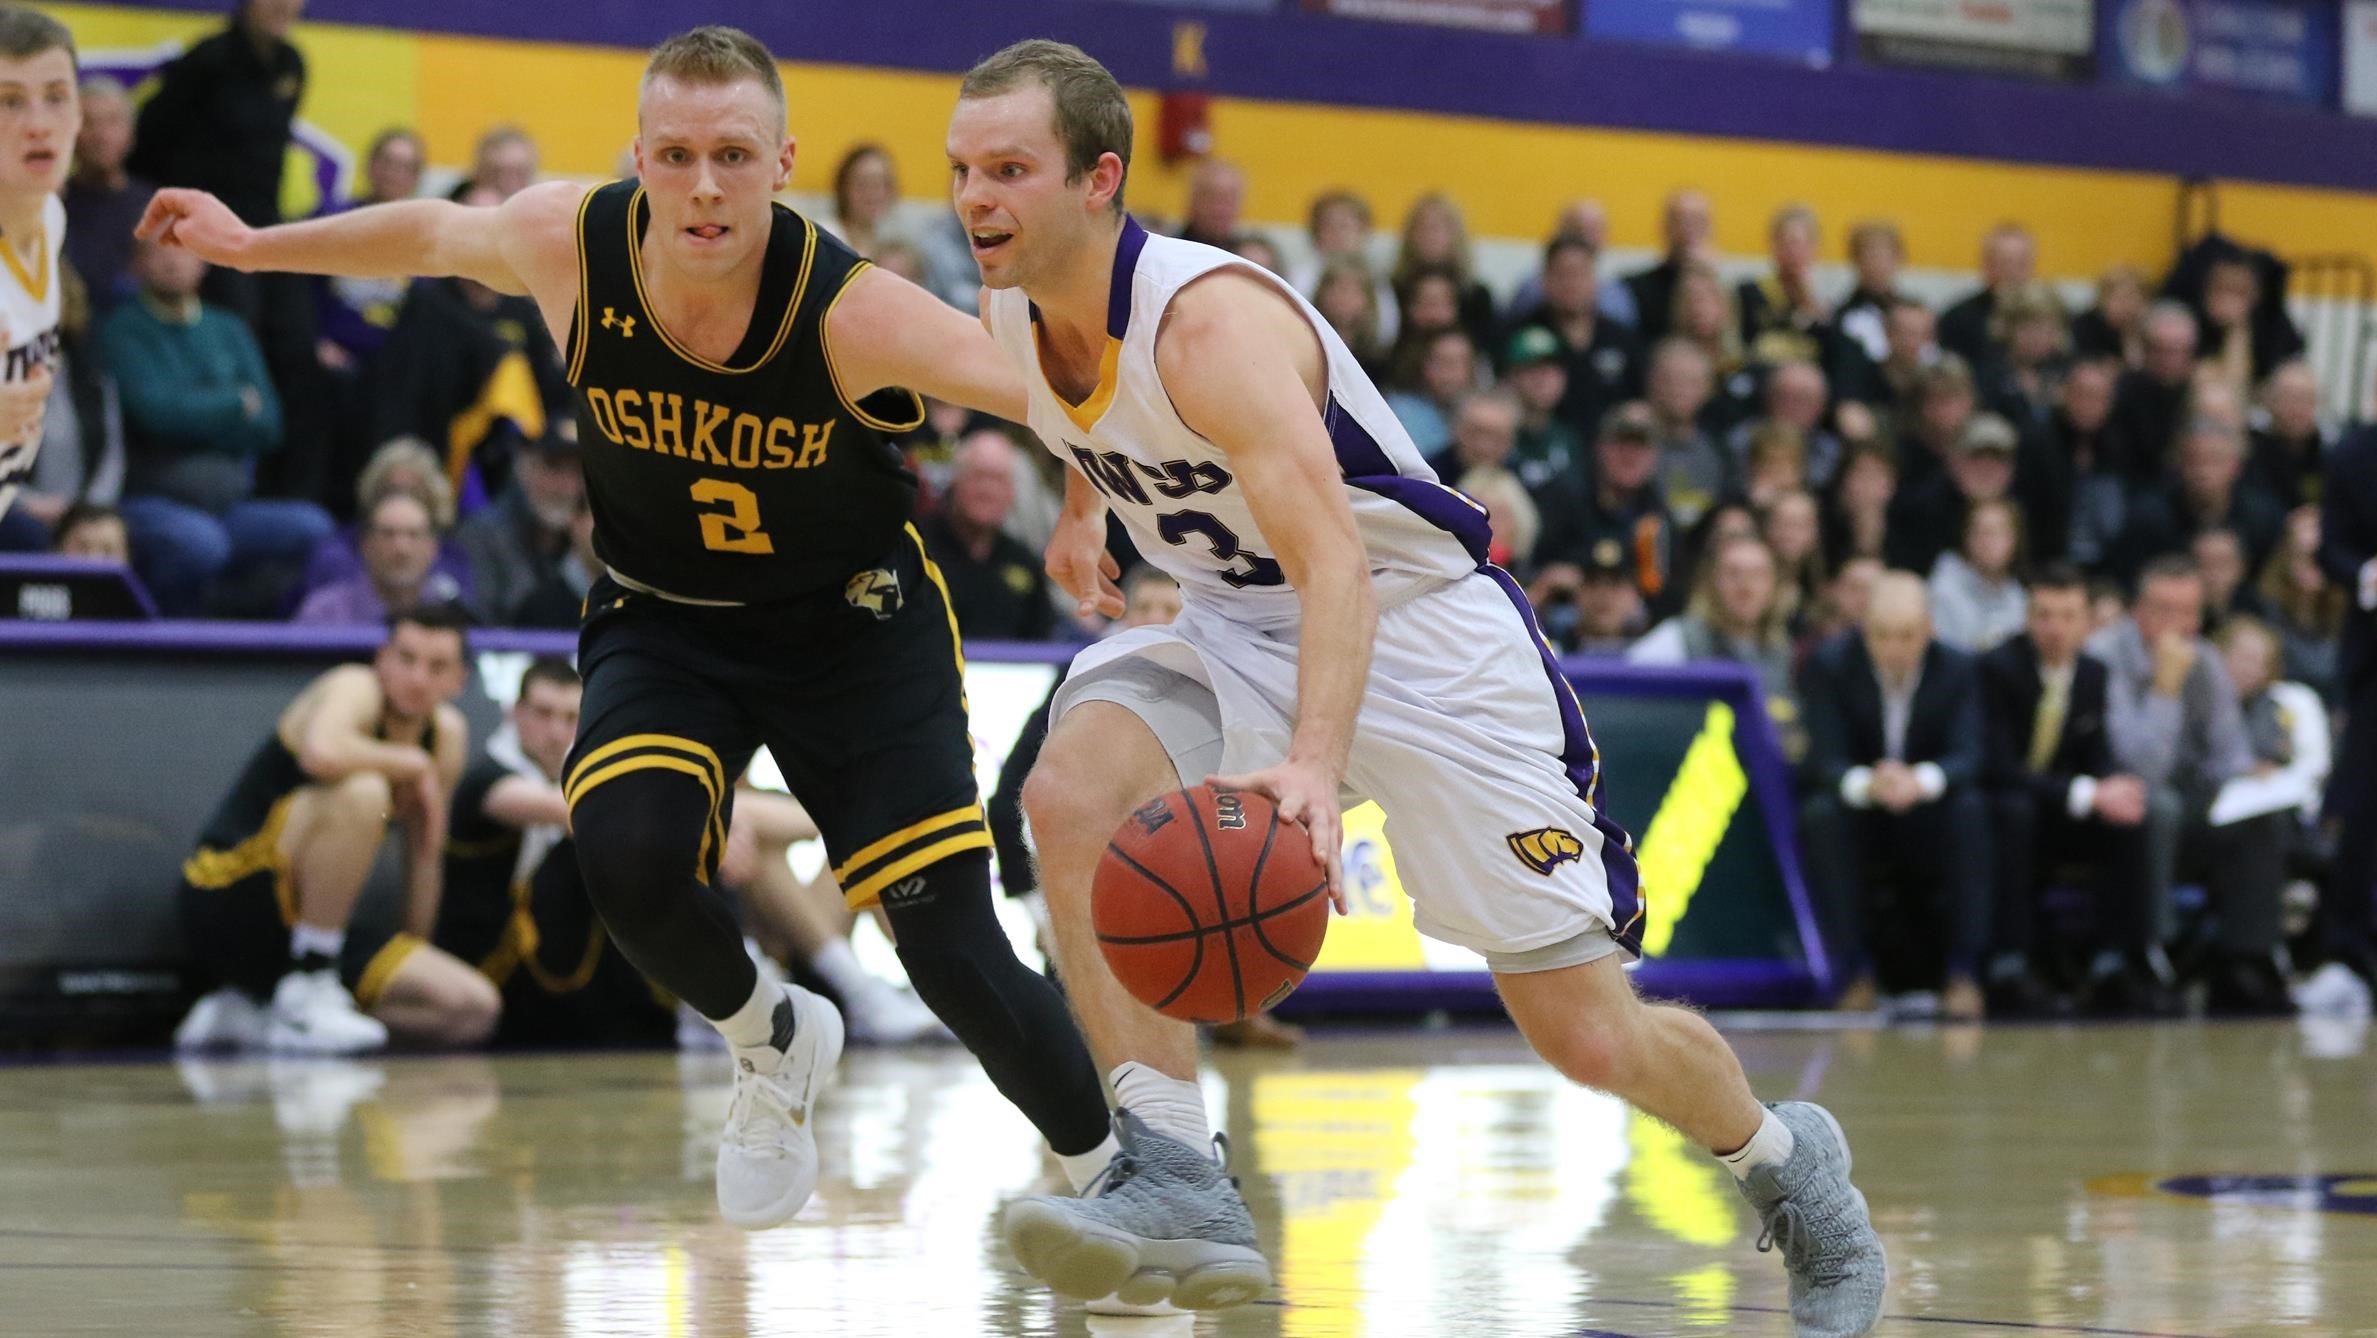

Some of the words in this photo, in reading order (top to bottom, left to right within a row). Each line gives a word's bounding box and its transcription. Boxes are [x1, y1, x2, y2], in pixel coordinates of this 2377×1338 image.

[586, 386, 837, 470] OSHKOSH
[689, 477, 775, 554] 2
[1156, 508, 1286, 590] 3
